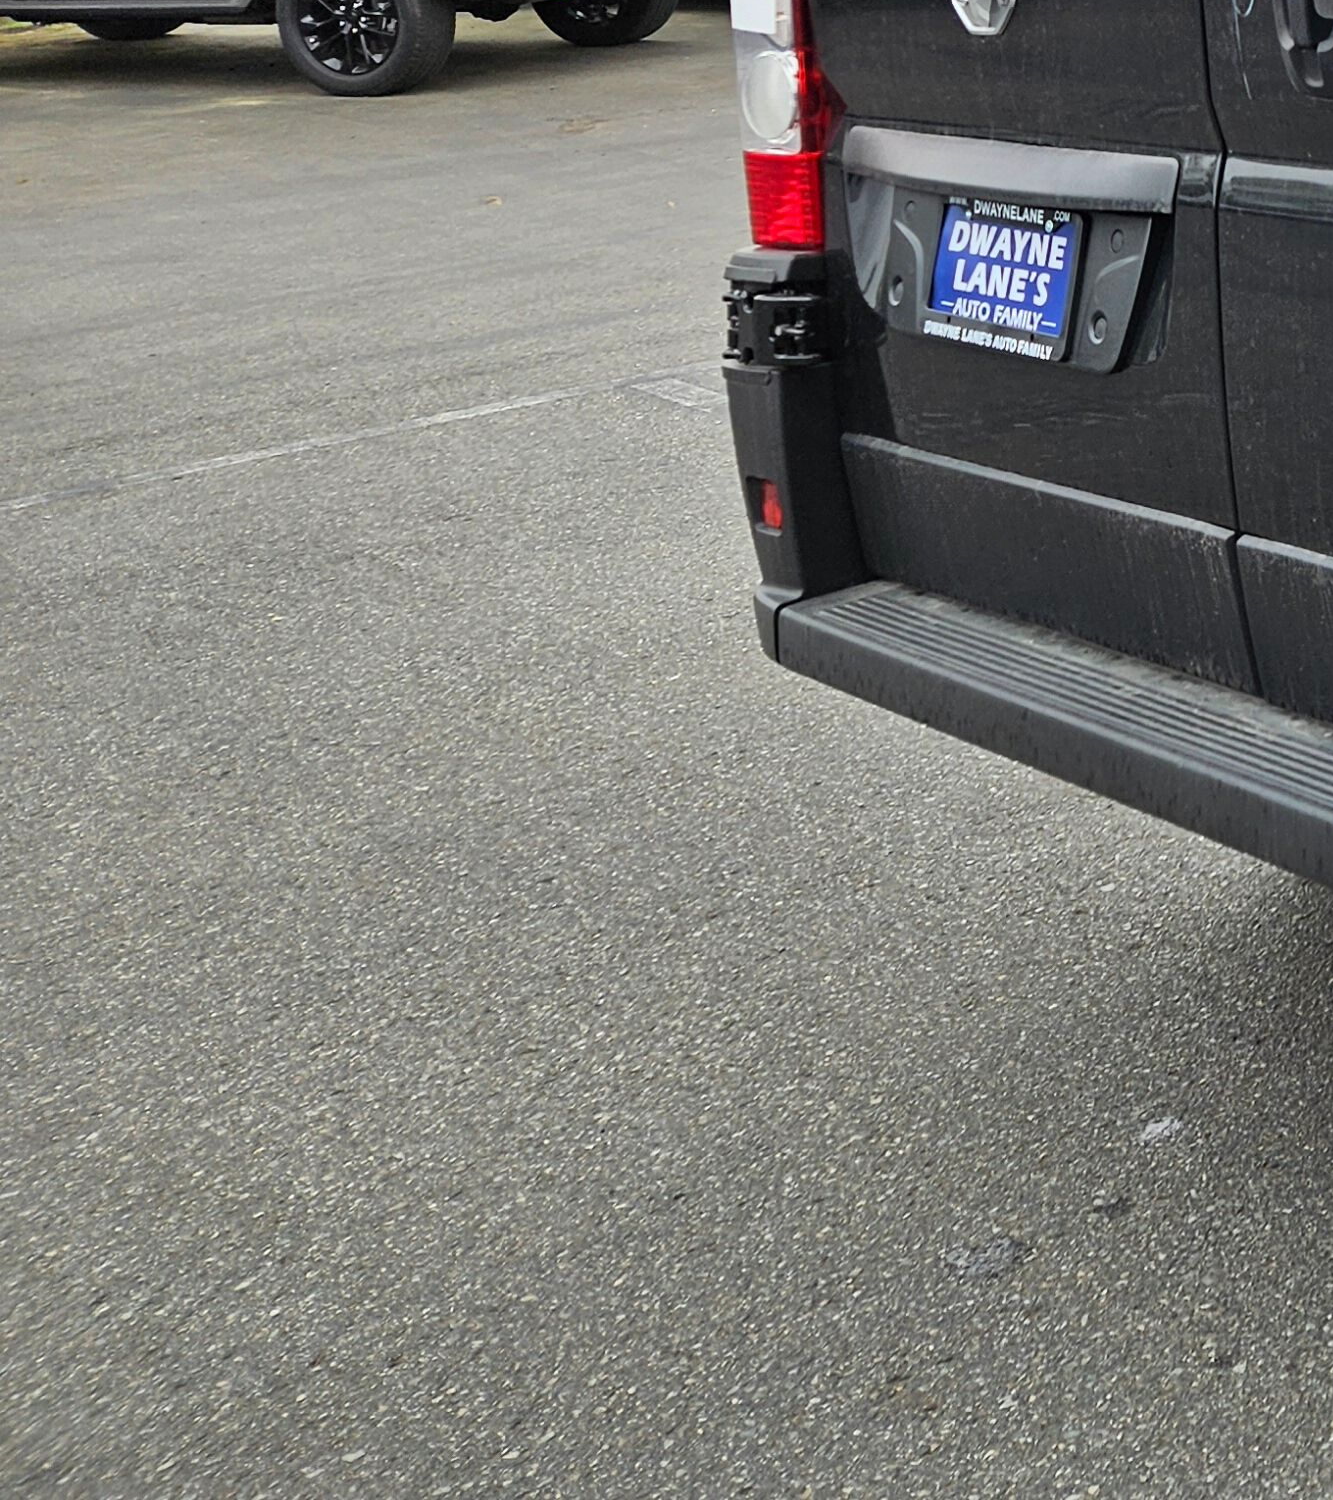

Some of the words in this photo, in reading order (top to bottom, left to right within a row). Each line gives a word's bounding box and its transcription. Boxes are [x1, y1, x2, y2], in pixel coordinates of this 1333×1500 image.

[974, 199, 1044, 225] DWAYNELANE
[948, 220, 1068, 270] DWAYNE
[953, 258, 1051, 307] LANE'S
[952, 297, 990, 323] AUTO
[993, 304, 1043, 332] FAMILY
[923, 319, 961, 341] DWAYNE
[961, 328, 993, 348] LANE'S
[992, 335, 1017, 353] AUTO
[1017, 339, 1053, 361] FAMILY
